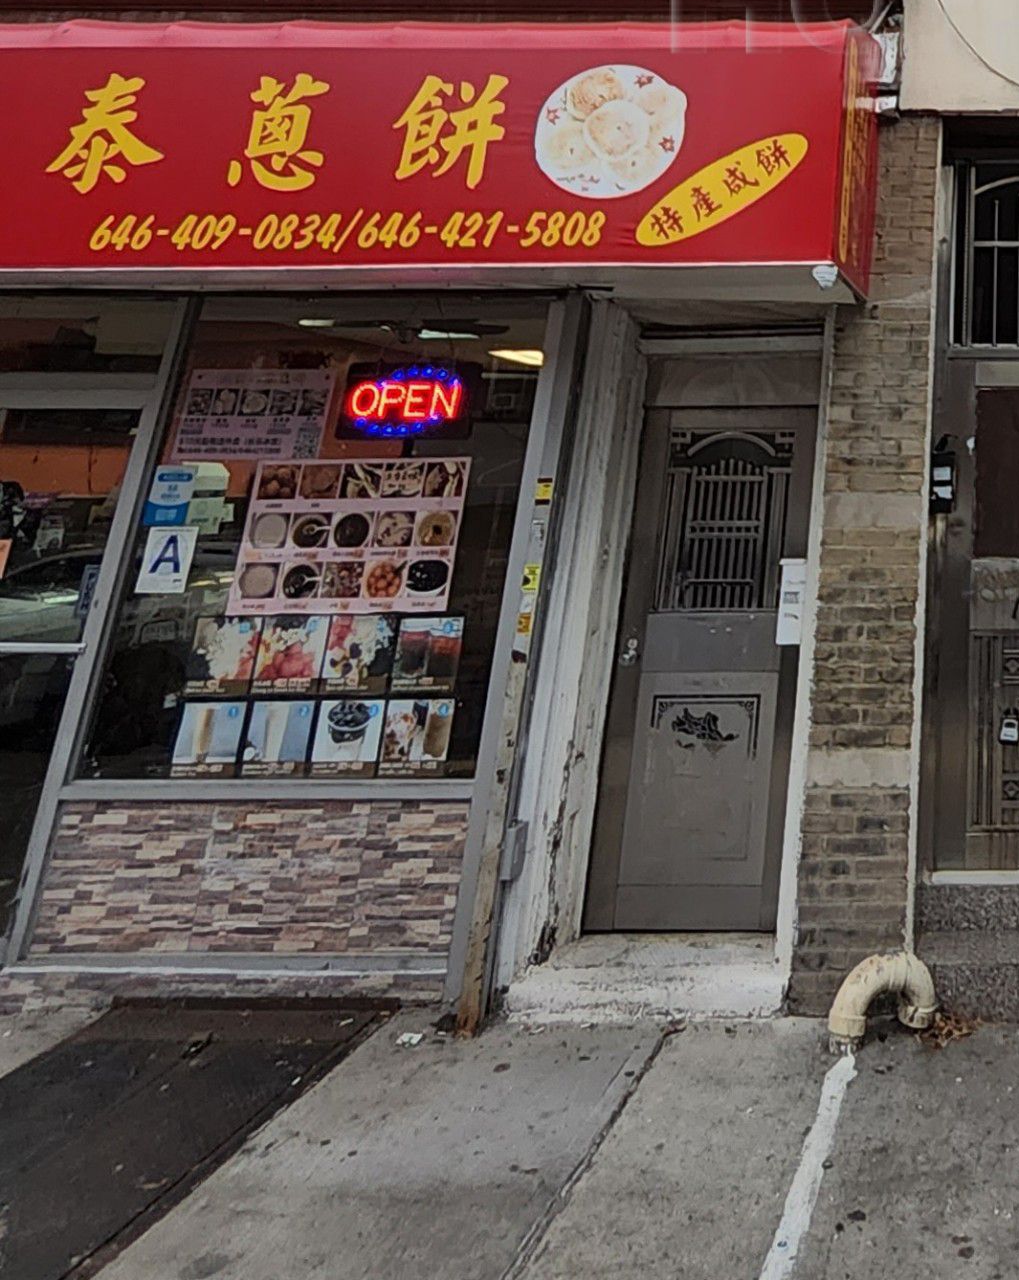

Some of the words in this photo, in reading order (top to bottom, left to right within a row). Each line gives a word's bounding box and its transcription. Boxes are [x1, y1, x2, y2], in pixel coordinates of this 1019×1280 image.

[89, 207, 606, 254] 646-409-0834/646-421-5808
[349, 379, 462, 420] OPEN
[147, 533, 182, 575] A
